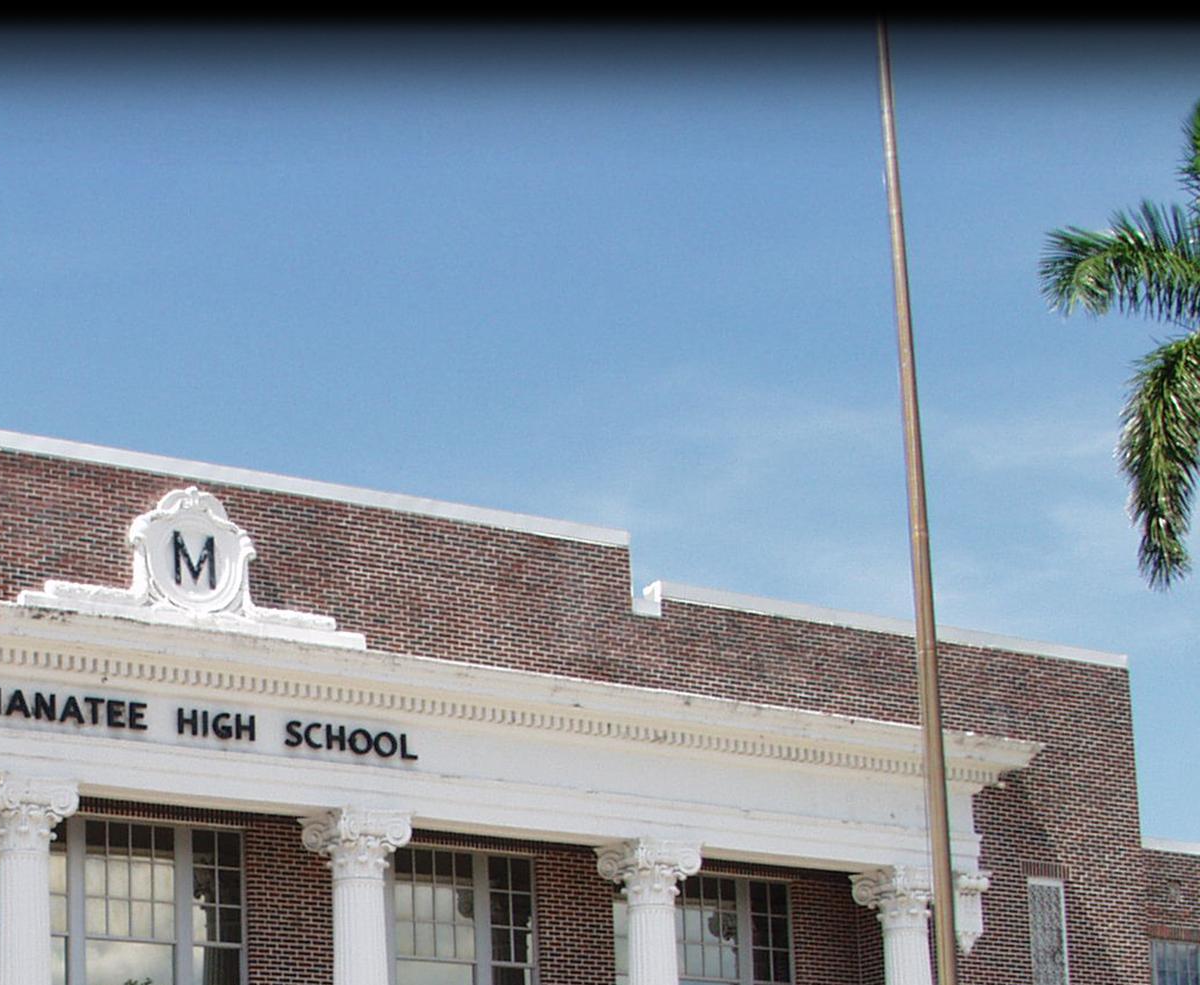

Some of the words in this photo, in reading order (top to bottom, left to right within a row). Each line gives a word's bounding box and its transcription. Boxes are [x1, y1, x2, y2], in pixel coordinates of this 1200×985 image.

[172, 530, 217, 591] M
[176, 707, 257, 742] HIGH
[284, 720, 419, 761] SCHOOL
